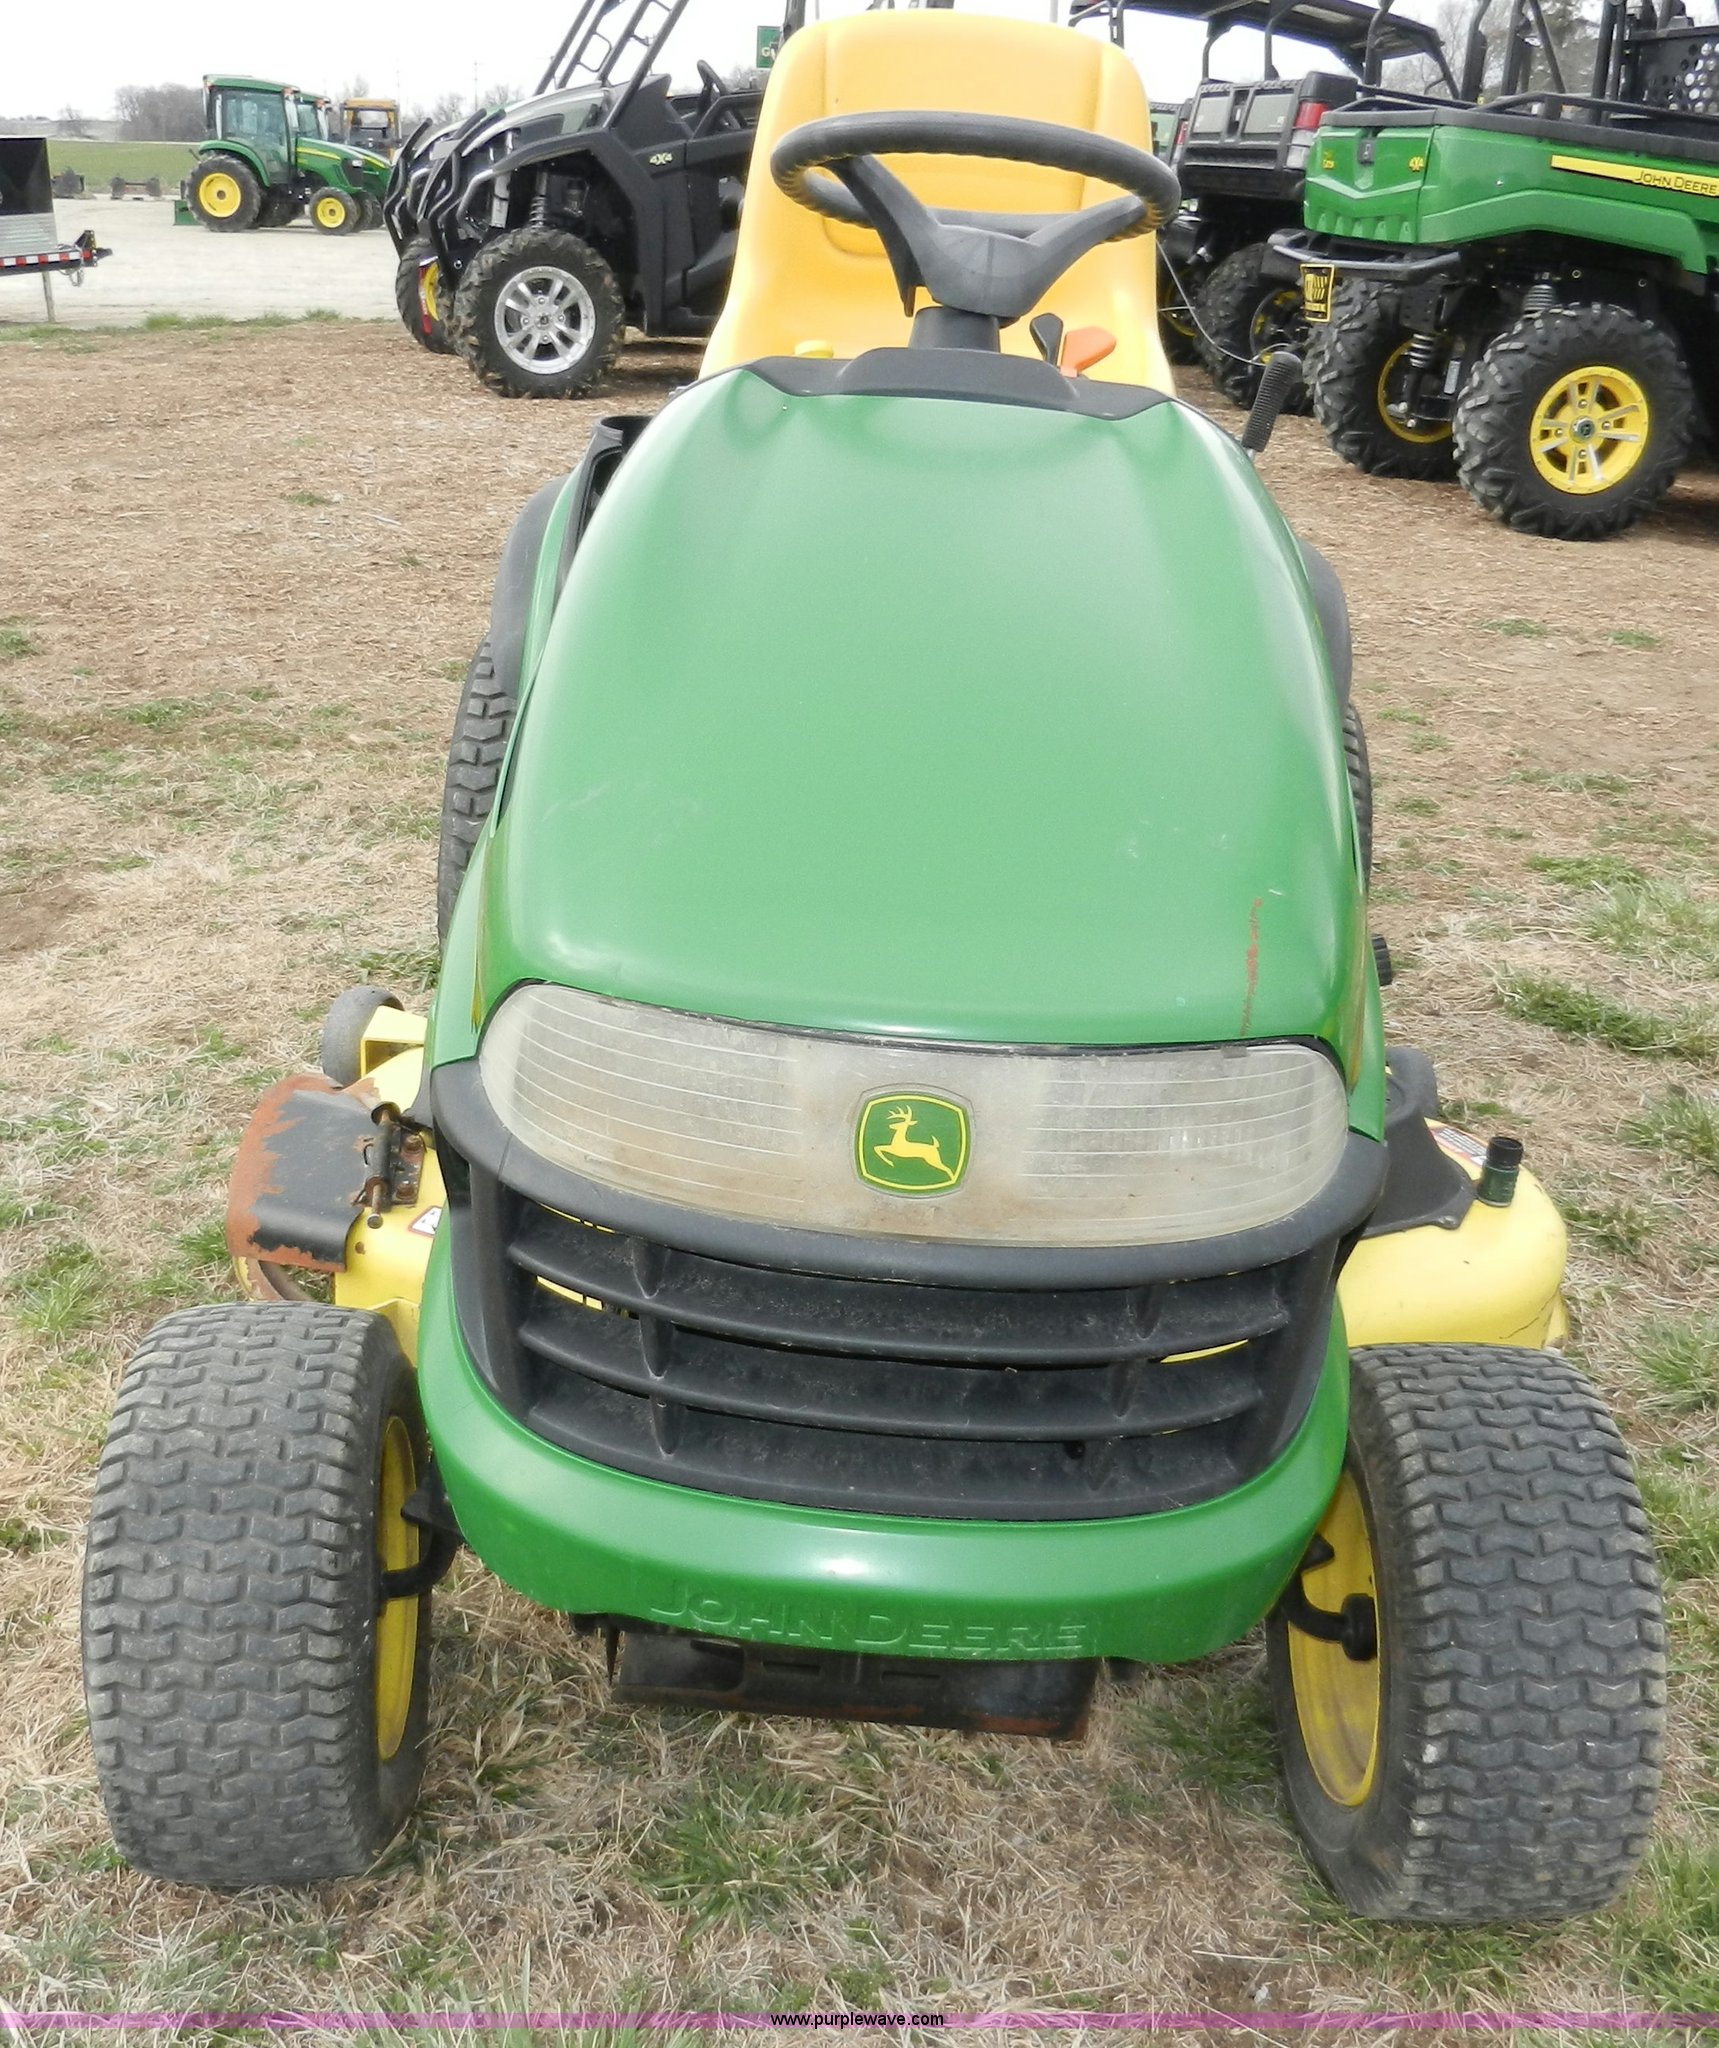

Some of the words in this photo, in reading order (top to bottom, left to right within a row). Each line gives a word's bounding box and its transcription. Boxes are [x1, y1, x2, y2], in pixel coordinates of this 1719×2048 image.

[1635, 171, 1672, 186] JOHN
[1674, 176, 1718, 194] DEERE
[650, 1581, 833, 1641] JOHN
[853, 1612, 1088, 1652] DEERE
